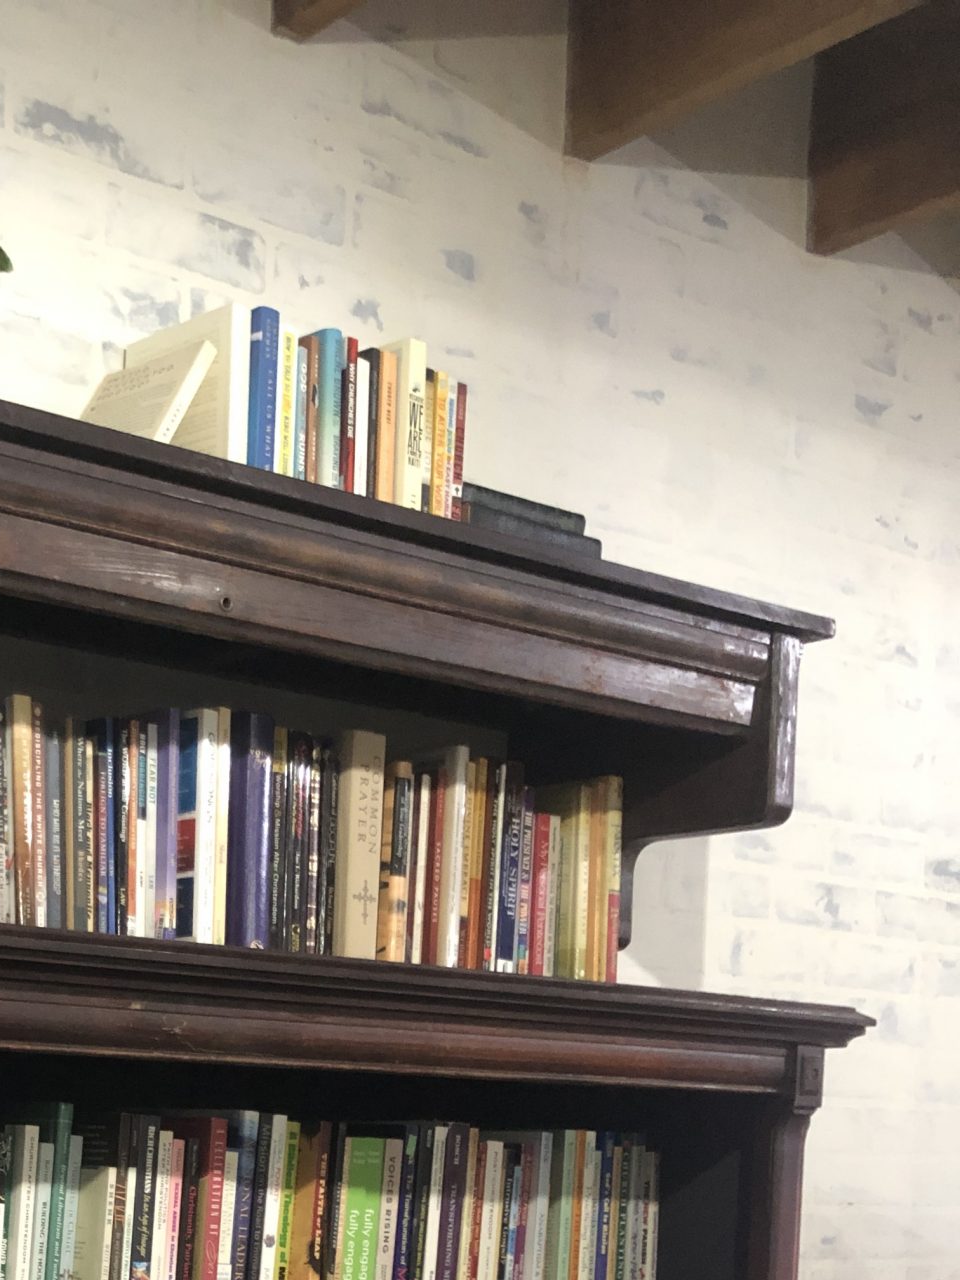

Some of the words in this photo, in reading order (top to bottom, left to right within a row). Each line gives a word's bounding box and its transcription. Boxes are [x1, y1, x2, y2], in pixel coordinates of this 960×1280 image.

[409, 404, 424, 430] WE
[76, 737, 84, 766] Where
[77, 781, 85, 816] Nations
[357, 763, 369, 843] PRAYER
[368, 755, 381, 854] COMMON
[77, 819, 85, 842] Meet
[510, 817, 519, 858] HOLY
[271, 874, 279, 924] Christendom
[507, 867, 517, 919] SPIRIT
[385, 1156, 396, 1203] VOICES
[342, 1209, 359, 1236] fully
[357, 1209, 374, 1236] fully
[382, 1209, 392, 1254] RISING
